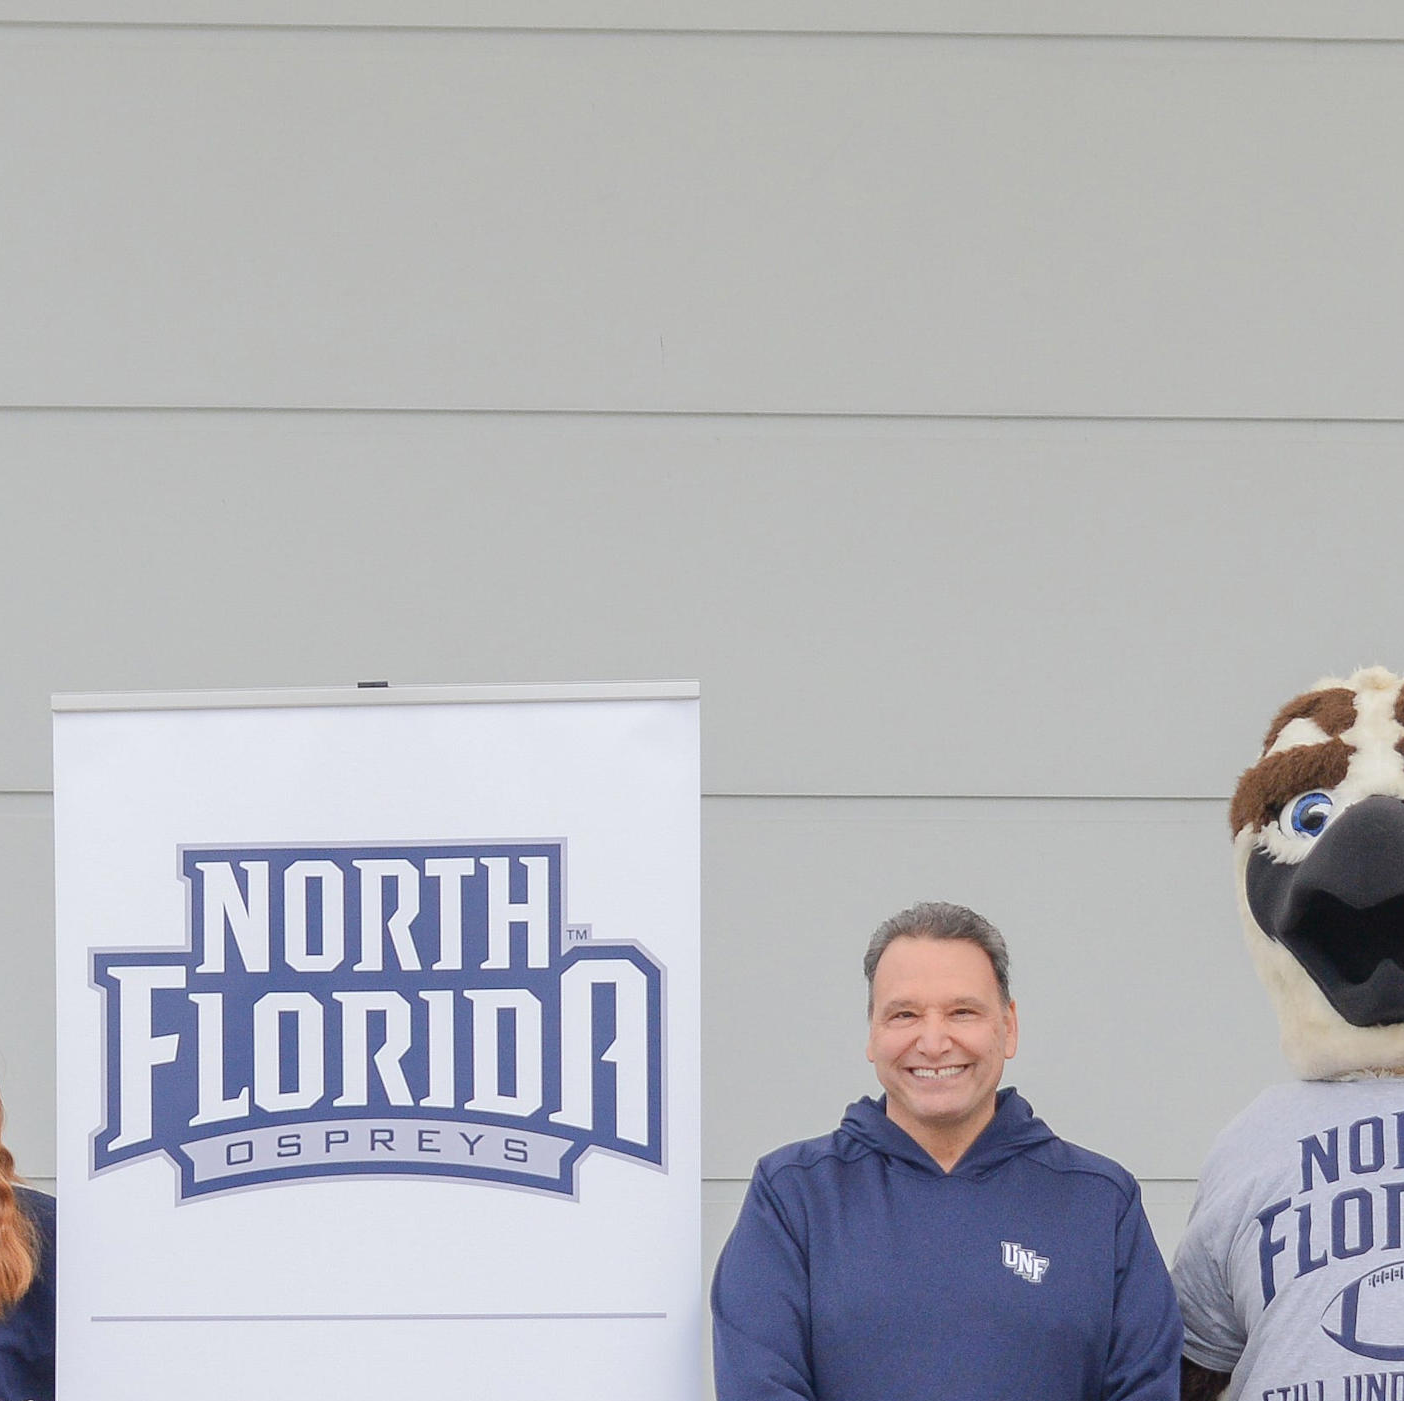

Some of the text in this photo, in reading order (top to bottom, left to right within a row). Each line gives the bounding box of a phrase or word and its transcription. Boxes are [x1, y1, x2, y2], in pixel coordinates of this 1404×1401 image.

[195, 855, 550, 974] NORTH
[106, 958, 649, 1152] FLORIDA
[224, 1129, 529, 1166] OSPREYS
[1000, 1241, 1050, 1283] UNF
